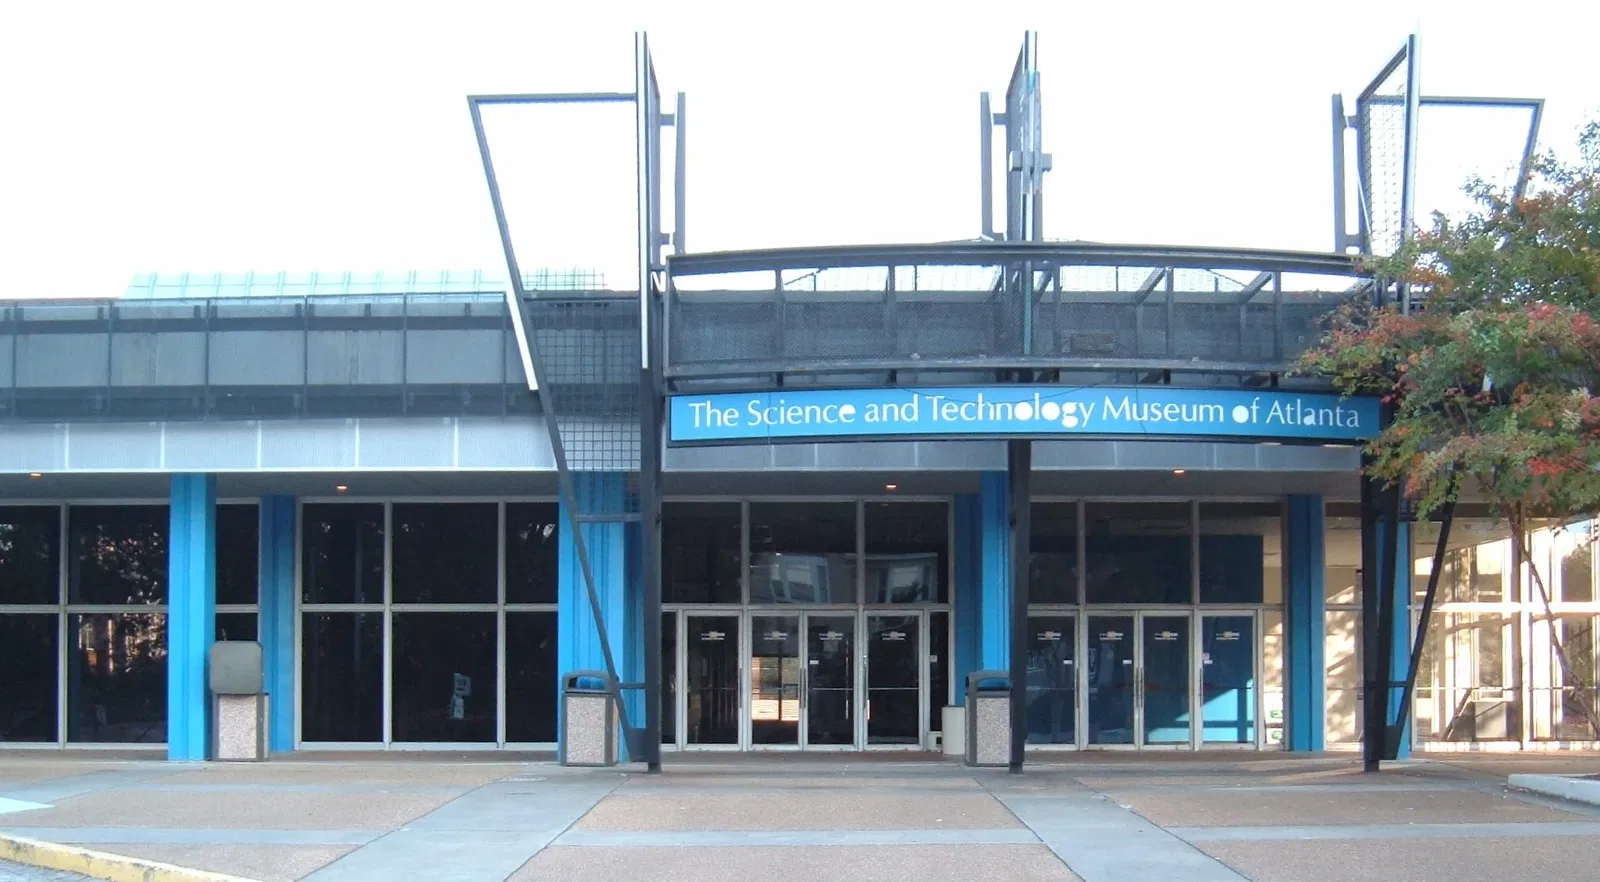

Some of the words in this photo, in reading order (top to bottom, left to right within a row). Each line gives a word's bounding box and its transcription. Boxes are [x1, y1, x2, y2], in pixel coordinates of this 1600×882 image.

[688, 400, 739, 428] The
[748, 399, 857, 427] Science
[863, 394, 920, 423] and
[926, 392, 1095, 429] Technology
[1102, 396, 1224, 423] Museum
[1231, 397, 1260, 424] of
[1266, 398, 1360, 427] Atlanta
